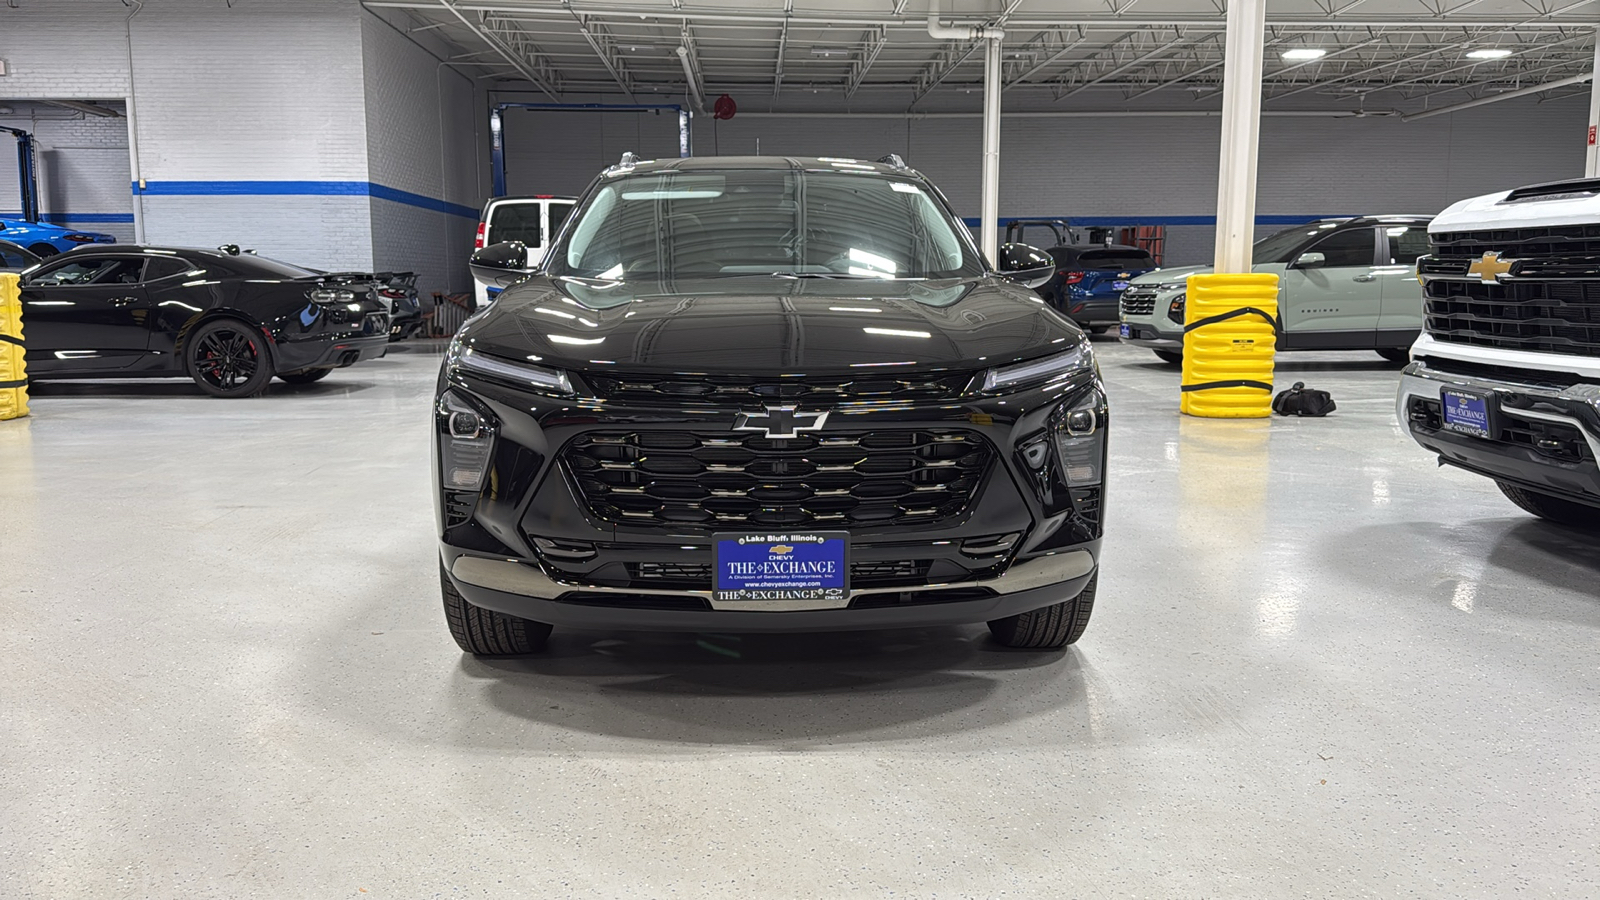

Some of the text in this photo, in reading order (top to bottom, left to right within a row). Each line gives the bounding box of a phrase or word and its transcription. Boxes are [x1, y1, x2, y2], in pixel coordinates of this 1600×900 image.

[1446, 406, 1456, 414] THE
[1458, 408, 1486, 420] EXCHANGE
[728, 561, 836, 574] THE EXCHANGE
[718, 590, 818, 600] THE EXCHANGE
